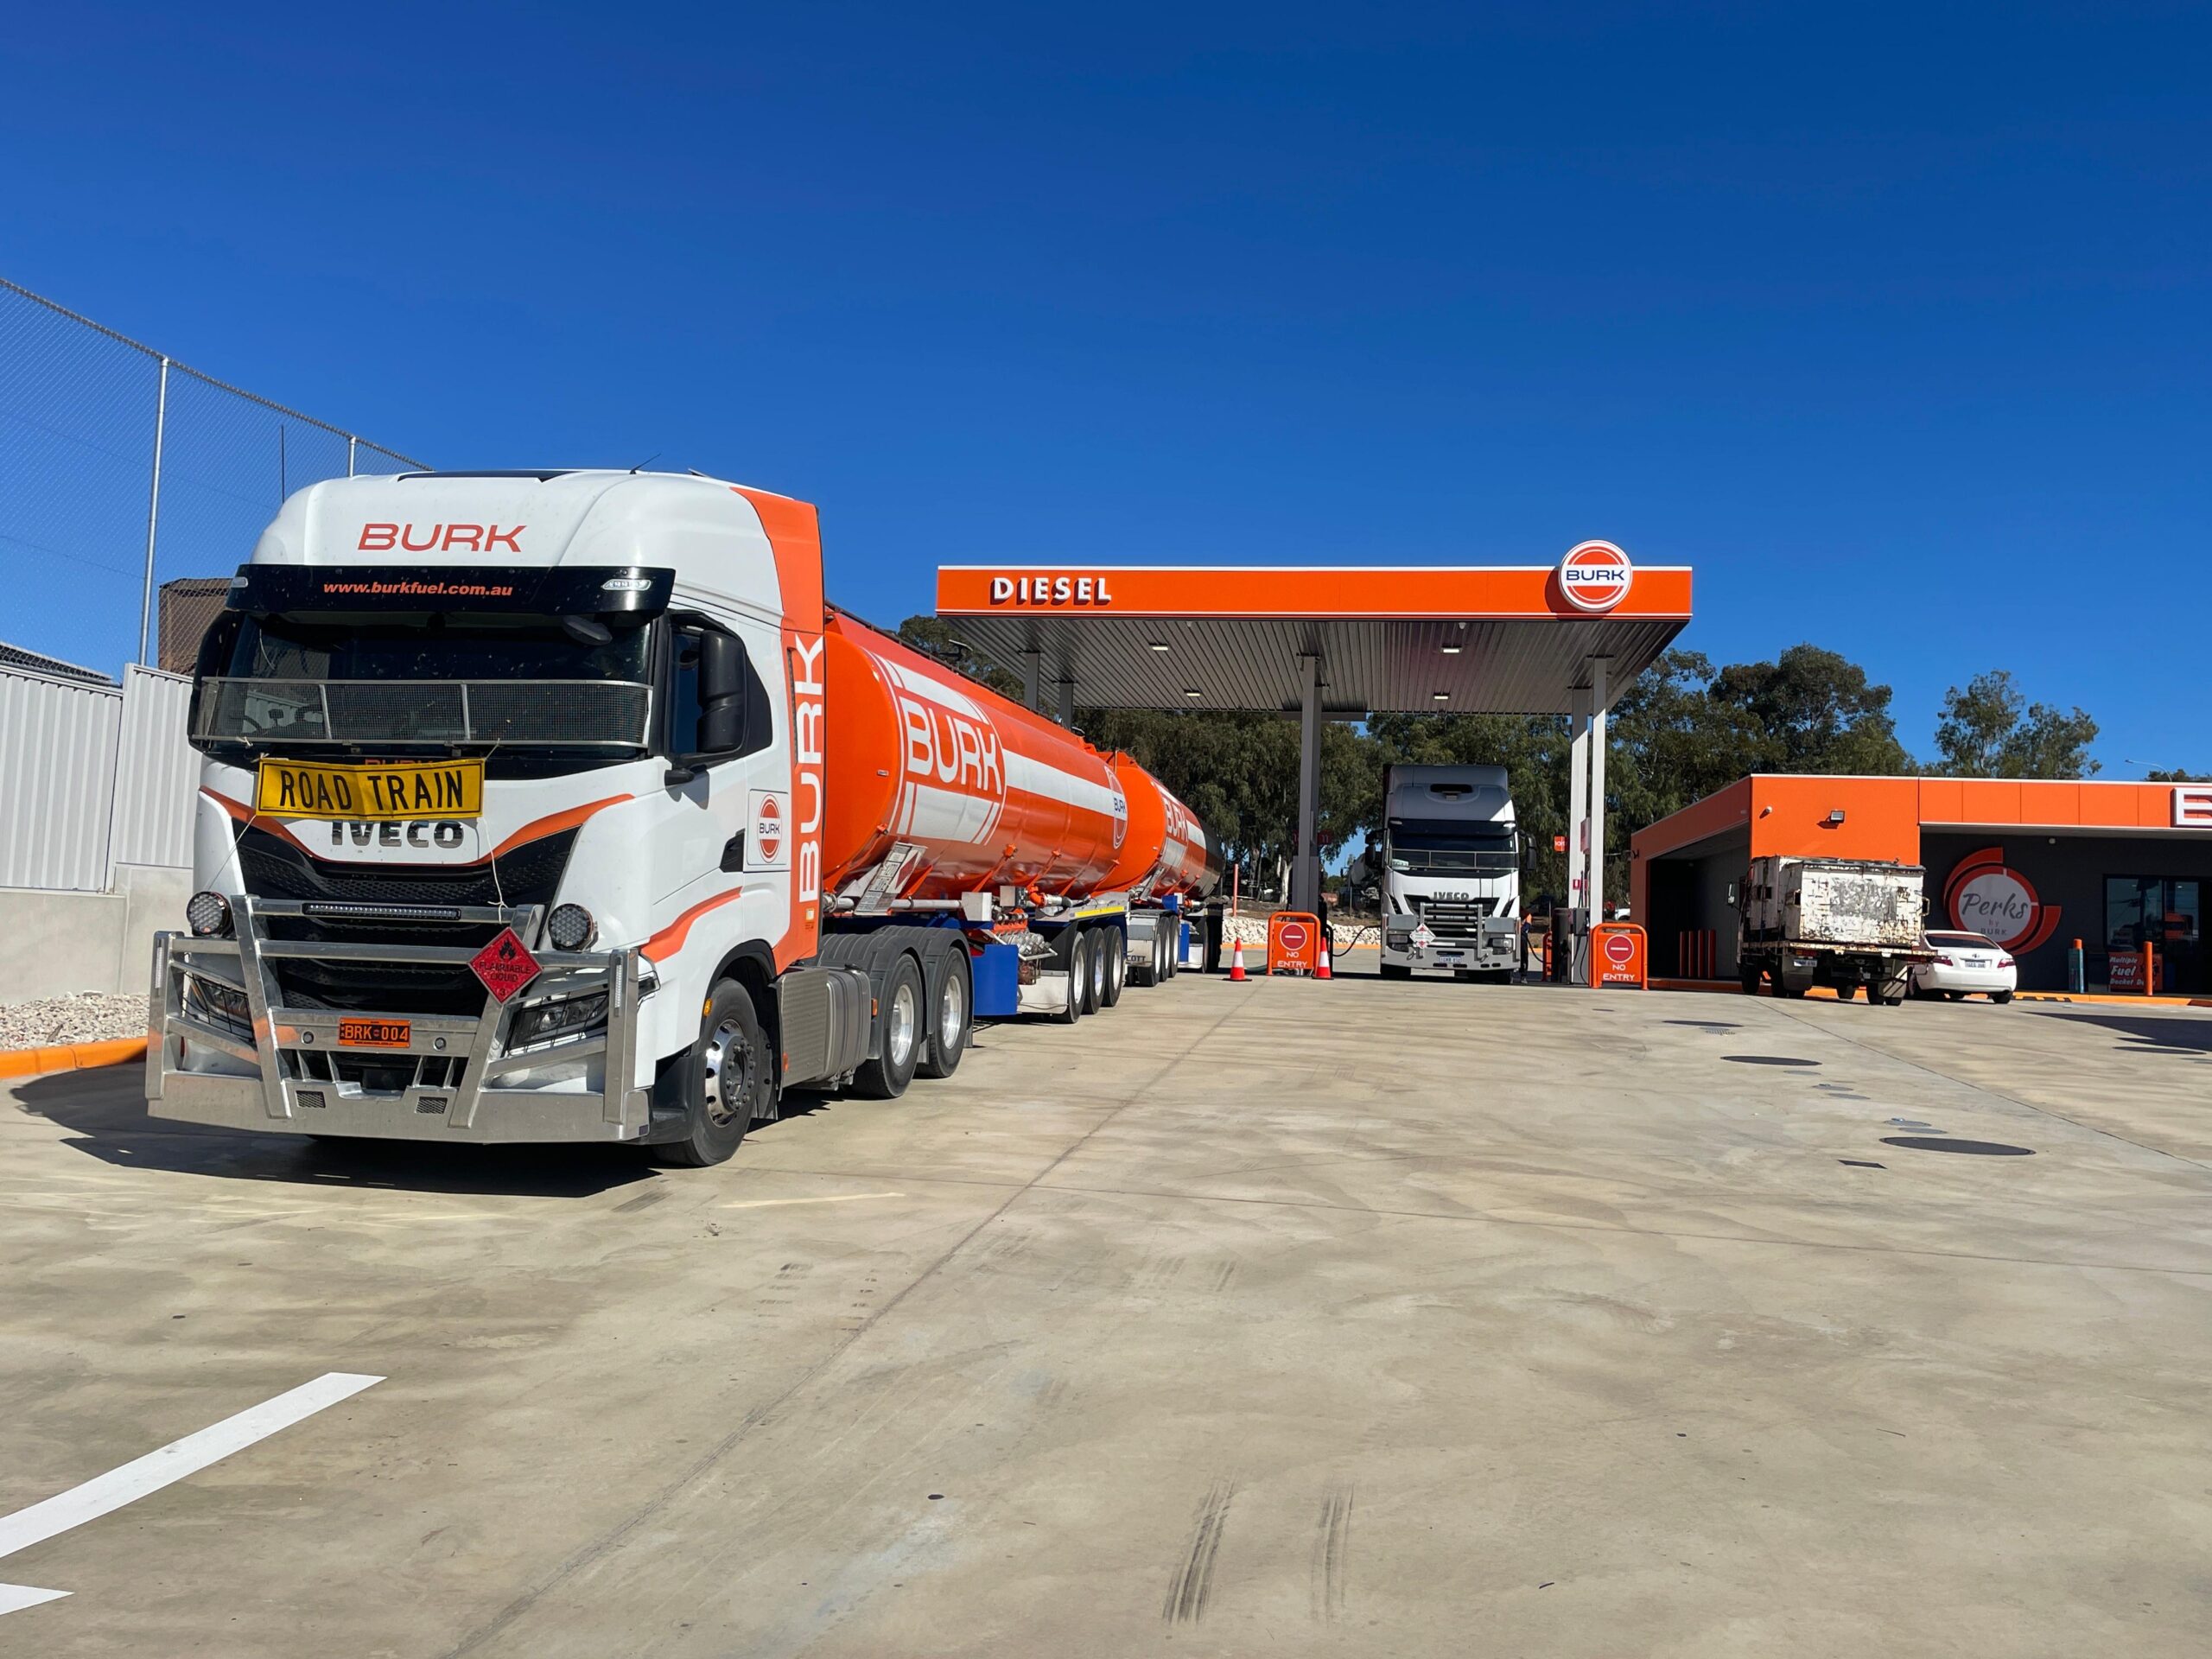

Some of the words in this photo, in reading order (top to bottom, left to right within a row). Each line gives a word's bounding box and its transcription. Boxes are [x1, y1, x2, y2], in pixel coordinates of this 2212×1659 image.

[358, 523, 527, 553] BURK
[1566, 569, 1624, 581] BURK
[323, 581, 513, 596] www.burkfuel.com.au
[993, 576, 1112, 601] DIESEL
[899, 696, 1002, 795] BURK
[795, 633, 823, 903] BURK
[280, 770, 353, 810] ROAD
[367, 770, 463, 810] TRAIN
[332, 819, 465, 849] IVECO
[759, 823, 780, 835] BURK
[1433, 891, 1470, 900] IVECO
[1961, 893, 2028, 919] Perks
[2109, 956, 2138, 964] Multiple
[480, 961, 532, 975] FLAMMABLE
[2111, 965, 2137, 976] Fuel
[1603, 973, 1635, 982] ENTRY
[345, 1025, 372, 1039] BRK
[381, 1027, 409, 1041] 004
